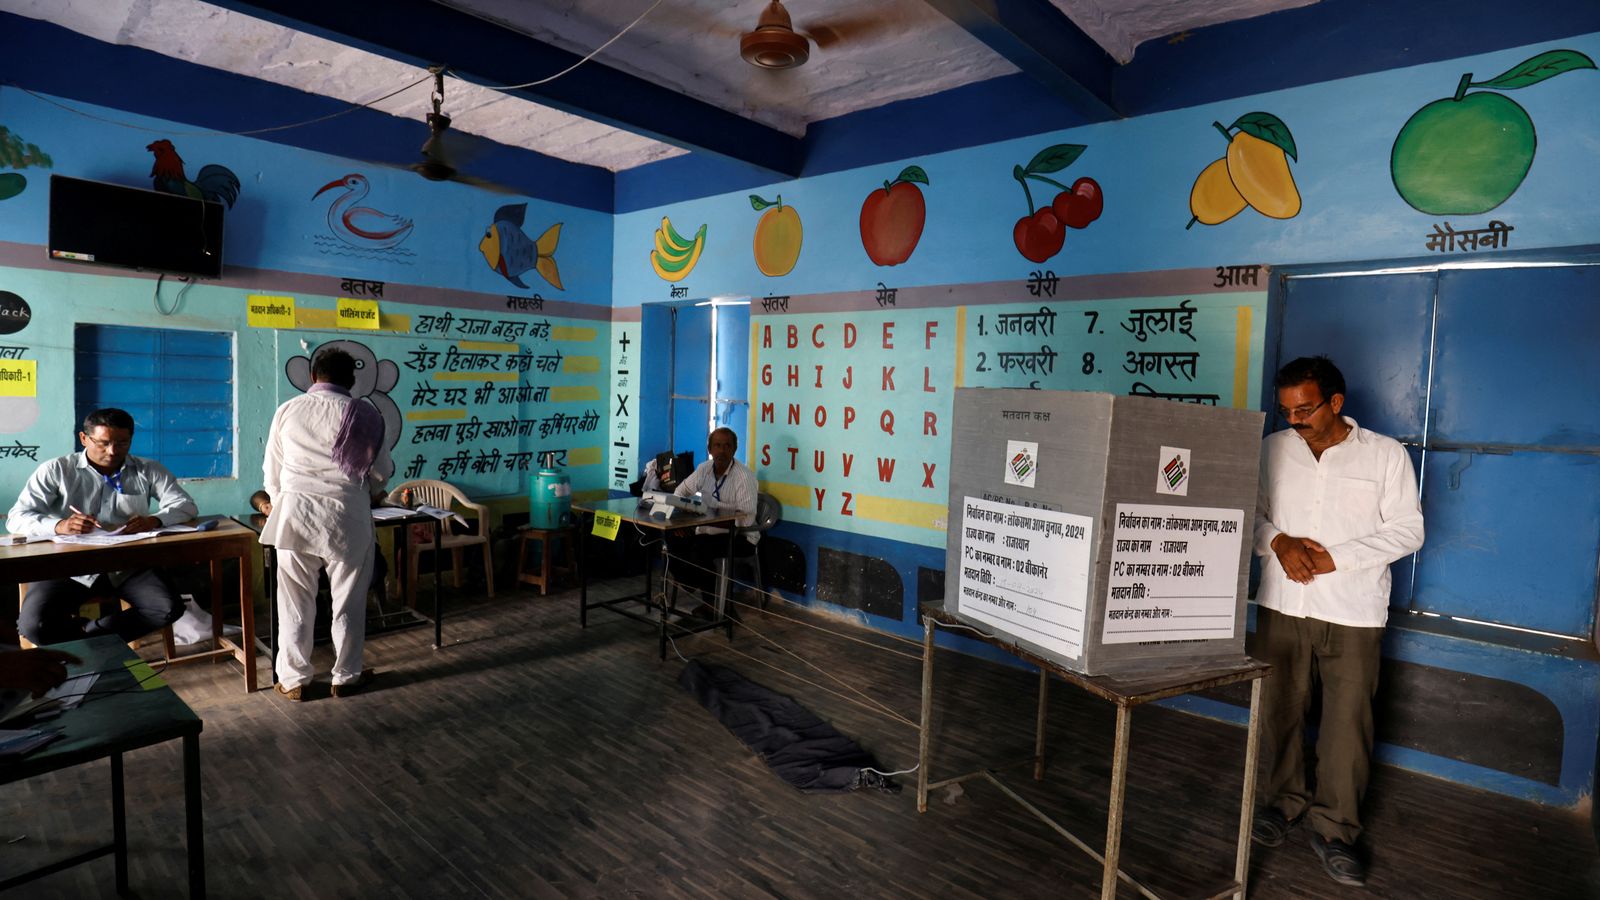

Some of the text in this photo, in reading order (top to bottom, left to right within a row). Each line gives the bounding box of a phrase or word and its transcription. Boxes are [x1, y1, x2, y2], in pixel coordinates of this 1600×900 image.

[340, 278, 385, 298] बतख
[1214, 264, 1262, 288] आम
[506, 293, 544, 311] मछली
[670, 284, 688, 298] केला
[762, 292, 790, 312] संतरा
[876, 282, 898, 306] सेब
[456, 318, 492, 335] राजा
[492, 320, 528, 342] बहुत
[529, 319, 551, 342] बड़े
[978, 300, 1198, 342] 1. जनवरी 7. जुलाई
[763, 321, 938, 350] A B C D E F
[442, 346, 502, 372] हिलाकर
[505, 348, 534, 372] कहाँ
[536, 350, 563, 373] चले
[976, 344, 1200, 382] 2. फरवरी 8. अगस्त
[762, 364, 936, 392] G H I J K L
[412, 380, 439, 406] मेरे
[444, 388, 468, 406] घर
[474, 381, 496, 406] भी
[762, 402, 937, 436] M N O P Q R
[1002, 410, 1051, 422] मतदान कक्ष
[412, 424, 452, 444] हलवा
[404, 454, 427, 478] जी
[761, 444, 936, 488] S T U V W X
[815, 488, 853, 516] Y Z
[966, 504, 985, 520] निर्वाचन
[986, 510, 992, 520] का
[1008, 511, 1032, 530] लोकसभा
[1032, 519, 1045, 532] आम
[1065, 524, 1085, 540] 2024
[1119, 512, 1141, 528] निर्वाचन
[1142, 517, 1150, 529] का
[1166, 514, 1190, 530] लोकसभा
[1190, 519, 1203, 531] आम
[1221, 521, 1237, 533] 2024
[965, 527, 977, 540] राज्य
[978, 530, 984, 541] का
[985, 531, 995, 544] नाम
[1006, 535, 1030, 552] राजस्थान
[1117, 540, 1131, 552] राज्य
[1131, 540, 1139, 552] का
[1140, 540, 1152, 552] नाम
[1164, 541, 1188, 553] राजस्थान
[965, 546, 974, 559] PC
[975, 549, 982, 562] का
[982, 552, 995, 565] नम्बर
[996, 555, 1000, 567] व
[1016, 561, 1024, 573] 02
[1025, 560, 1048, 579] बीकानेर
[1113, 562, 1125, 576] PC
[1126, 564, 1135, 576] का
[1136, 564, 1151, 576] नम्बर
[1151, 564, 1156, 576] व
[1173, 564, 1182, 576] 02
[1182, 561, 1205, 576] बीकानेर
[964, 567, 980, 582] मतदान
[980, 568, 992, 584] तिथि
[1111, 587, 1131, 599] मतदान
[1132, 583, 1146, 599] तिथि
[1109, 610, 1124, 620] मतदान
